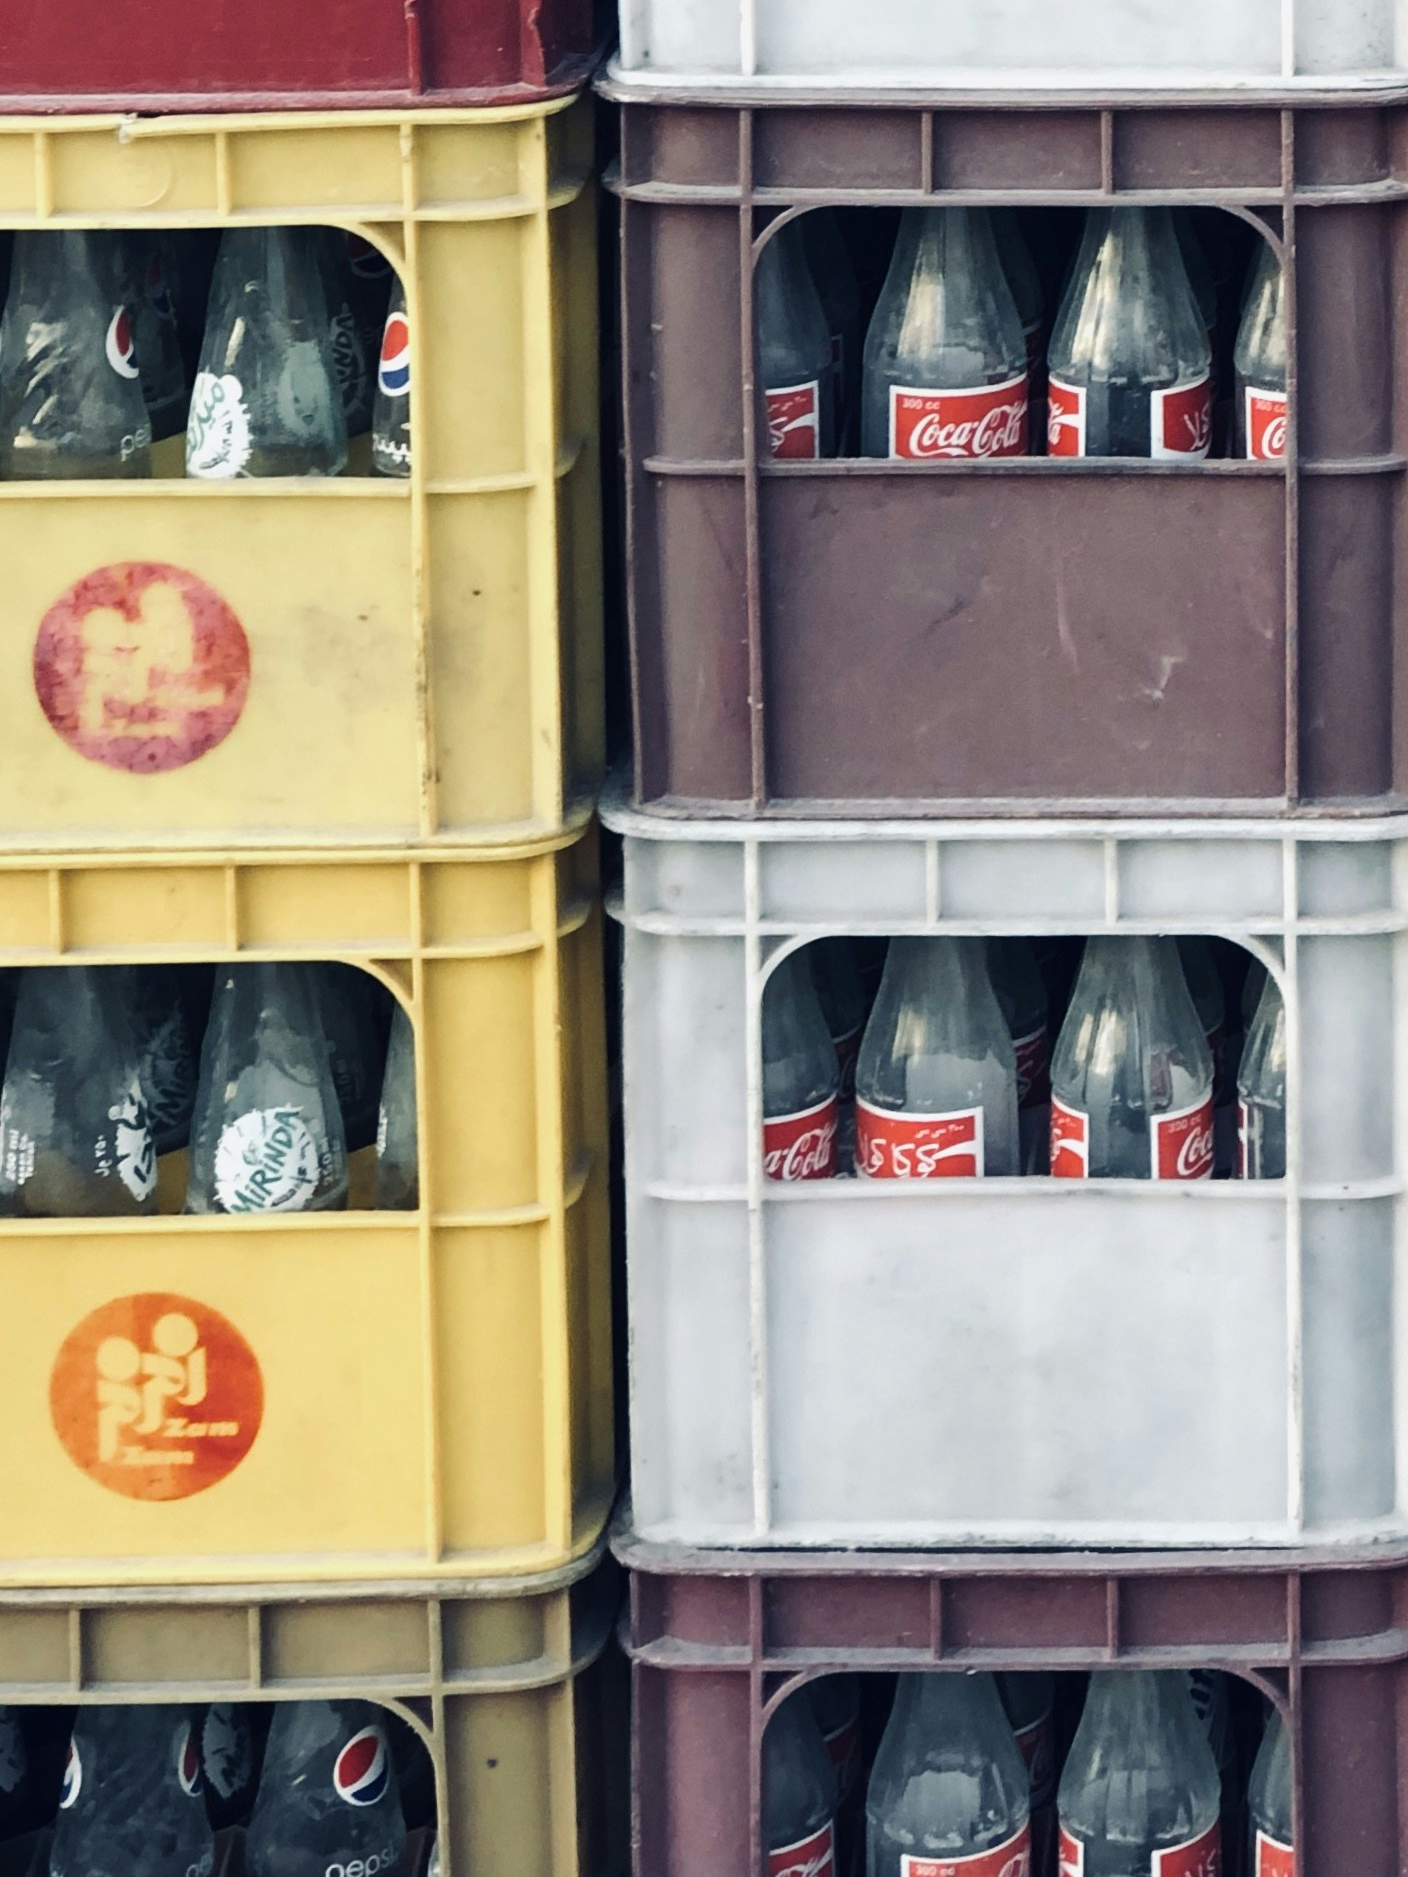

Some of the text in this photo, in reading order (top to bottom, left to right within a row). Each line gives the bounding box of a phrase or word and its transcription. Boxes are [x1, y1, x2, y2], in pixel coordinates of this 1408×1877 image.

[925, 399, 942, 410] cc
[909, 402, 1027, 458] Coca-Cola
[162, 1417, 241, 1438] Zam
